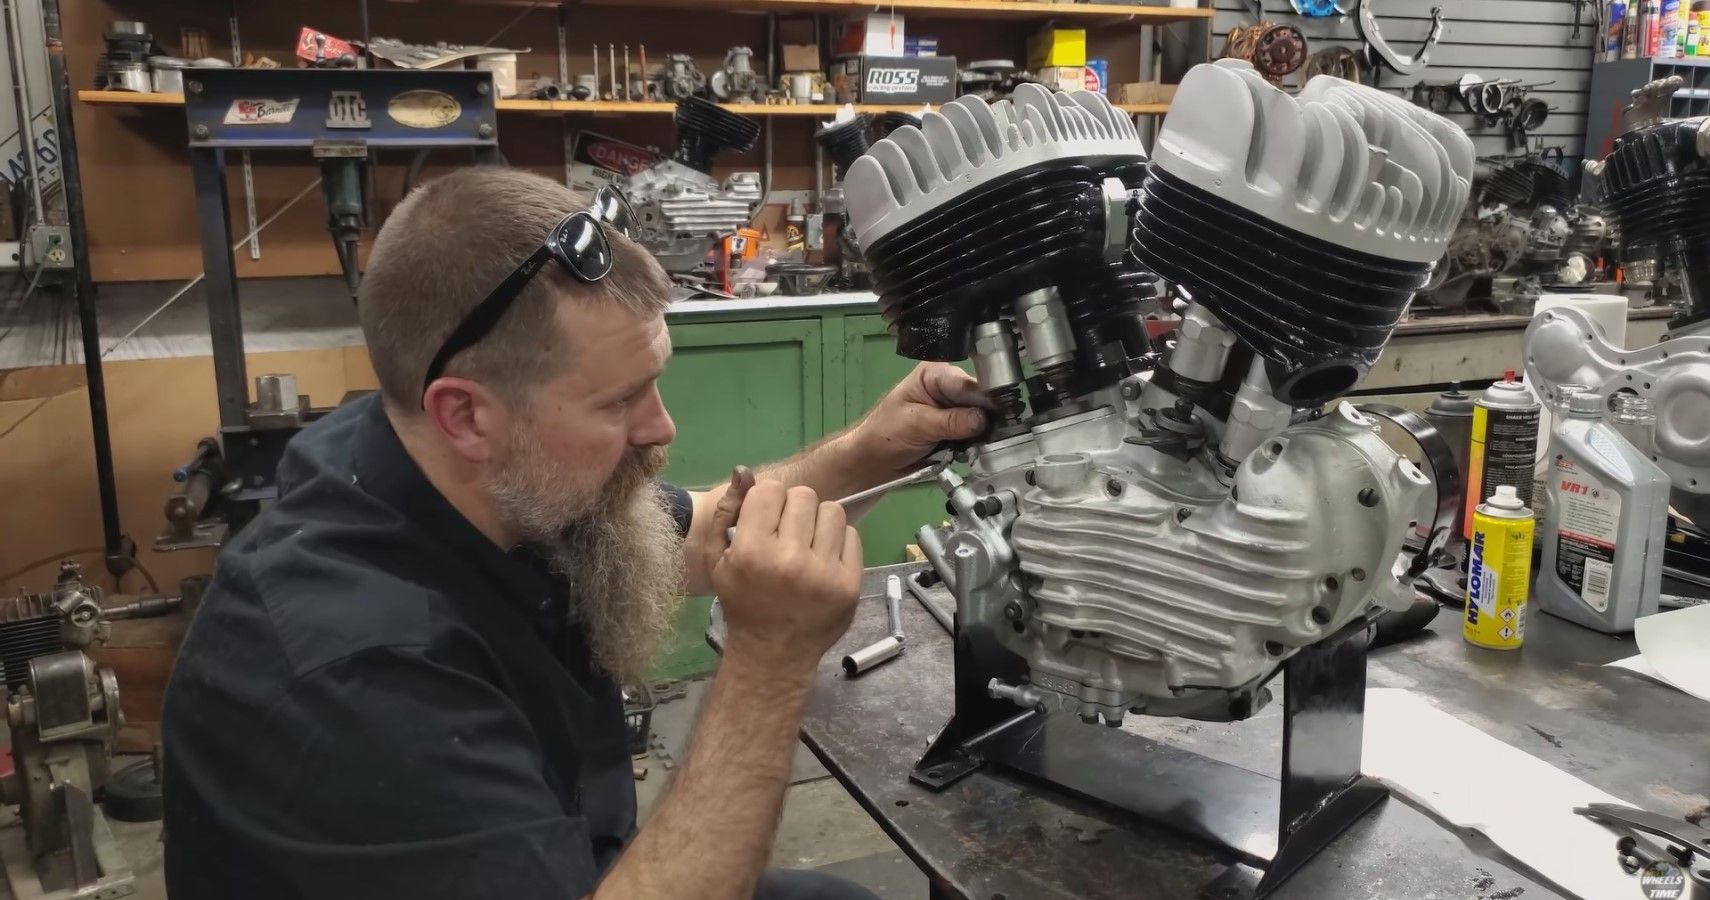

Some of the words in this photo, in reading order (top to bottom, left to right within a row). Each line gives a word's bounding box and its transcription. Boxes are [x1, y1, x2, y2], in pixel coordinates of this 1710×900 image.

[868, 70, 918, 85] ROSS
[1561, 480, 1589, 496] VR1
[1468, 531, 1485, 625] HYLOMAR
